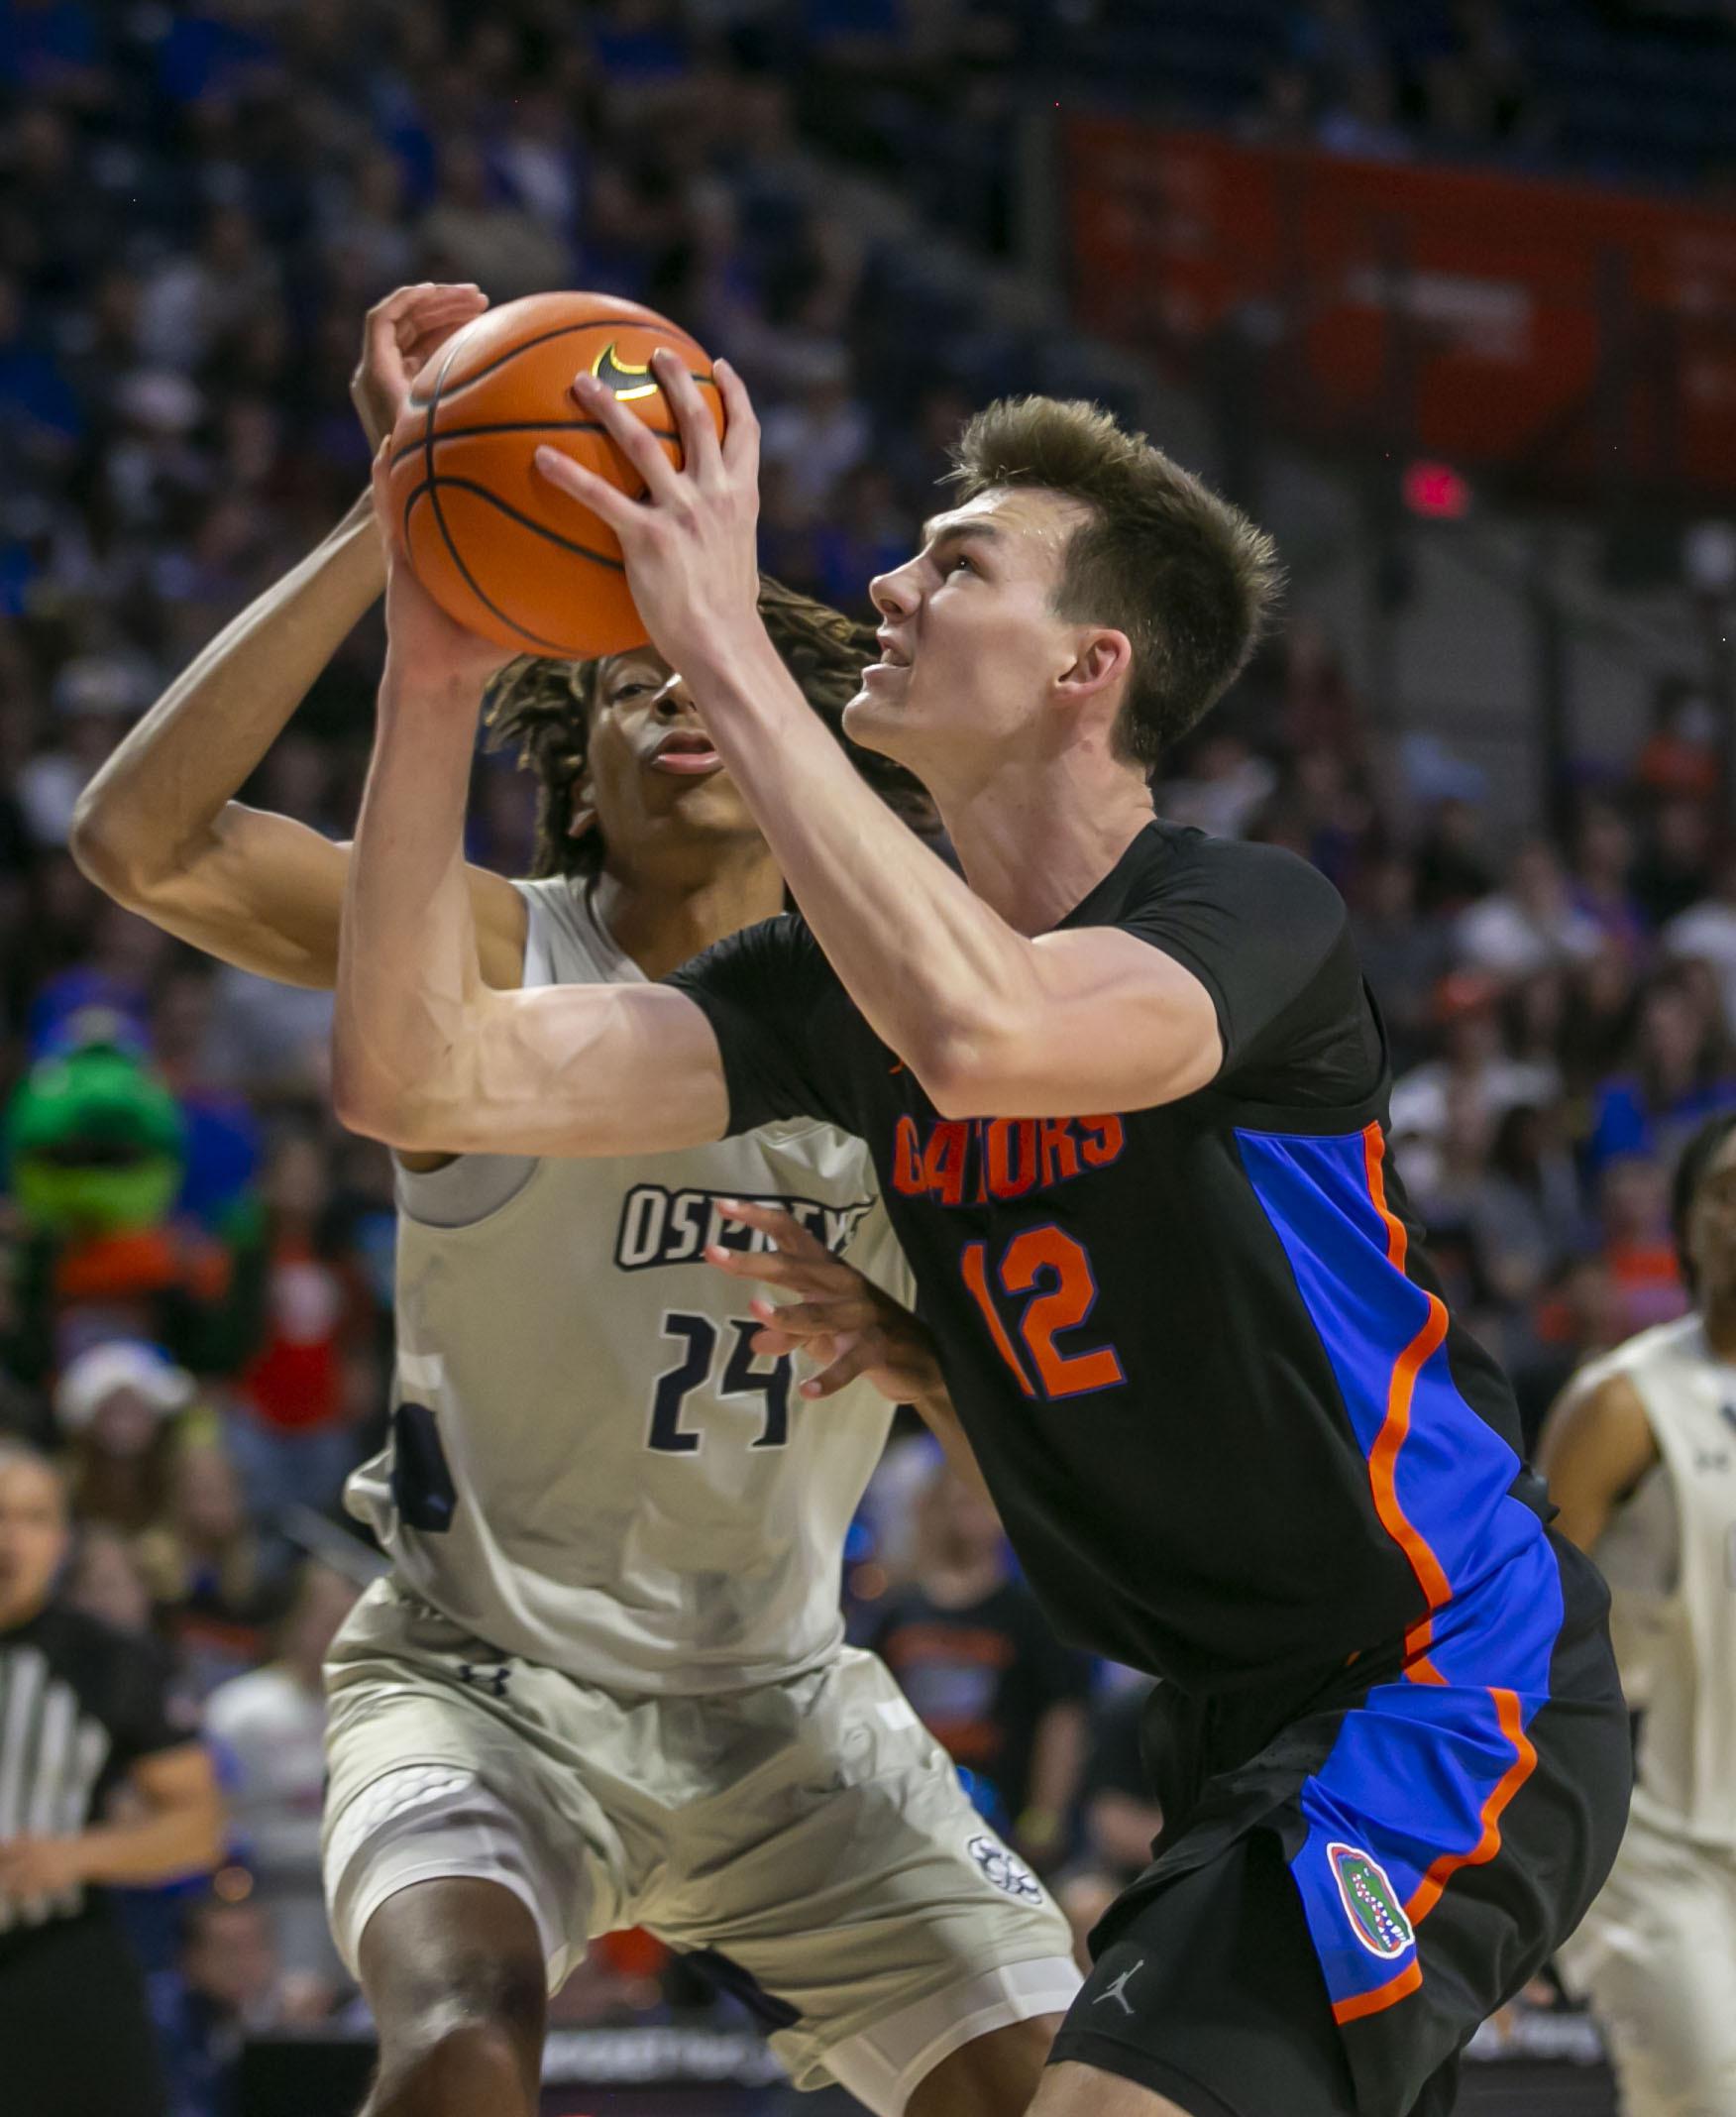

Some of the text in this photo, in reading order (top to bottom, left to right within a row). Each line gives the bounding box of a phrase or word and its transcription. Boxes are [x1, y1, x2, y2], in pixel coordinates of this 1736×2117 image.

[894, 1114, 1125, 1205] GAORS
[647, 1310, 793, 1455] 24
[961, 1224, 1126, 1399] 12
